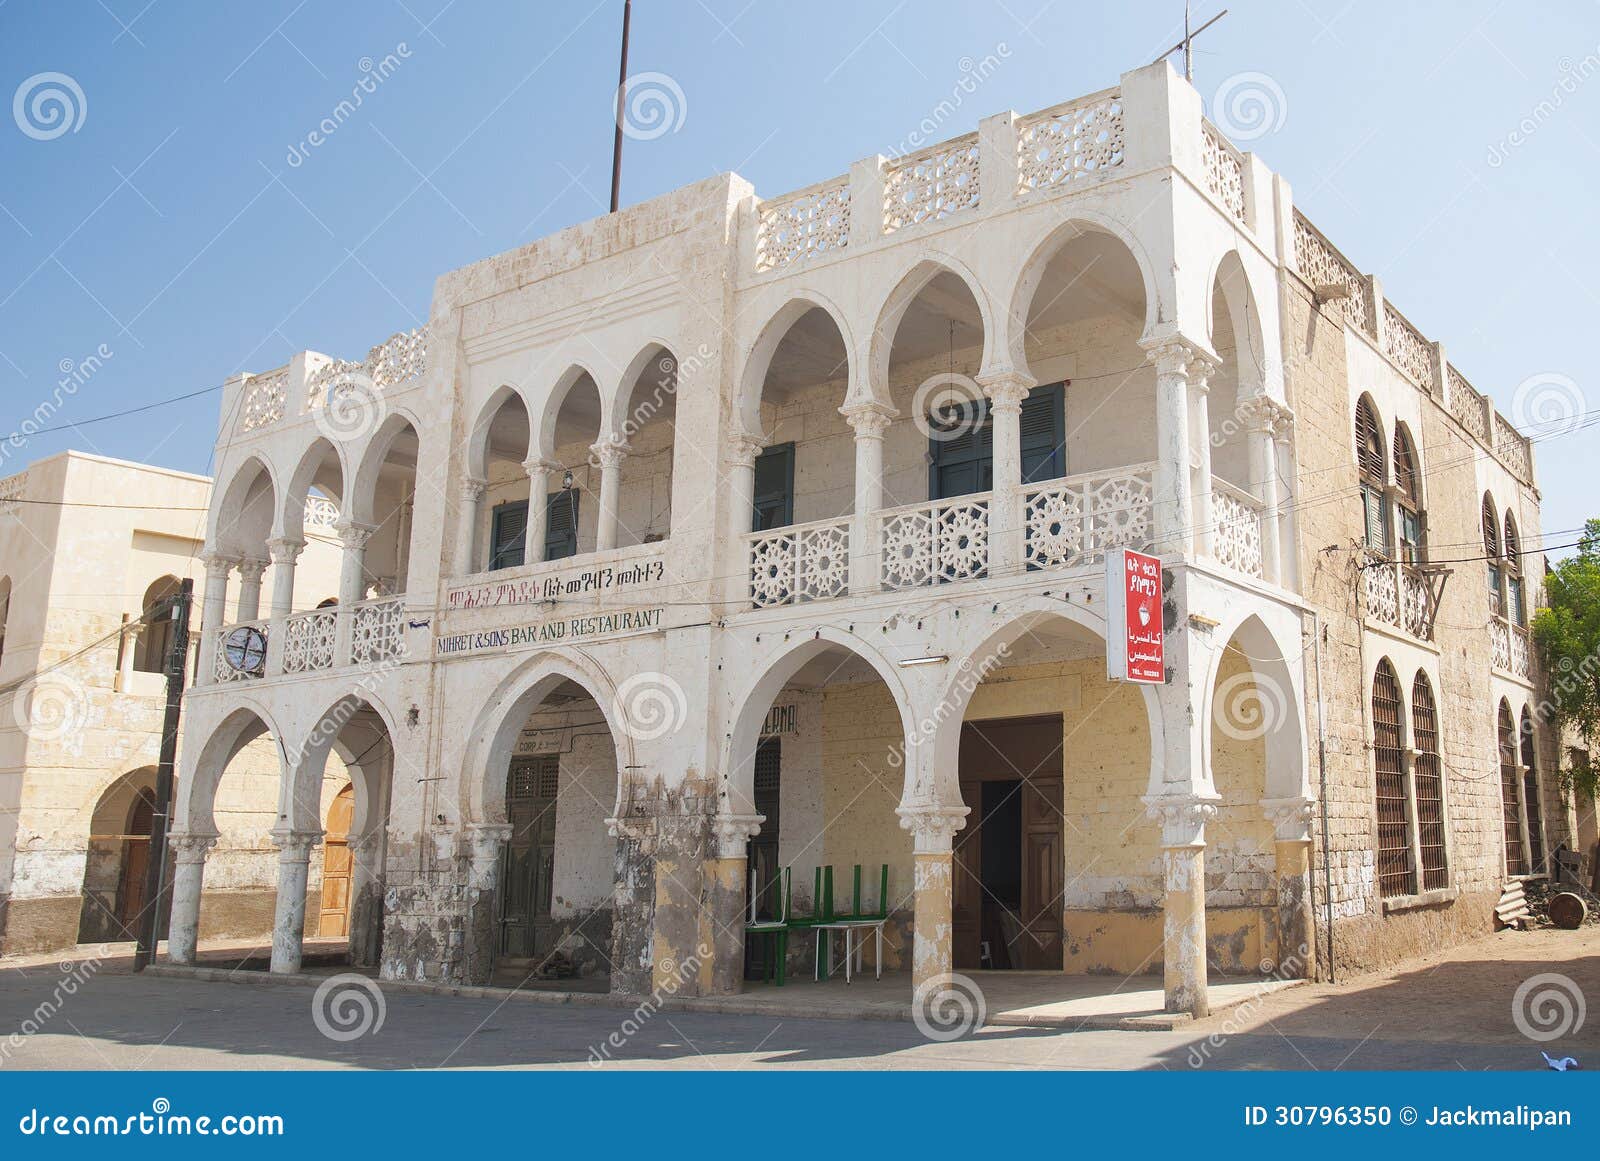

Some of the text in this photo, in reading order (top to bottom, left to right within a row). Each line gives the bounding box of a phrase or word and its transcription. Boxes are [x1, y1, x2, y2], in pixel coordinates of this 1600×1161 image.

[438, 634, 474, 654] MIHRET
[484, 629, 509, 647] SONS
[511, 626, 536, 645] BAR
[539, 621, 565, 641] AND
[571, 609, 664, 637] RESTAURANT
